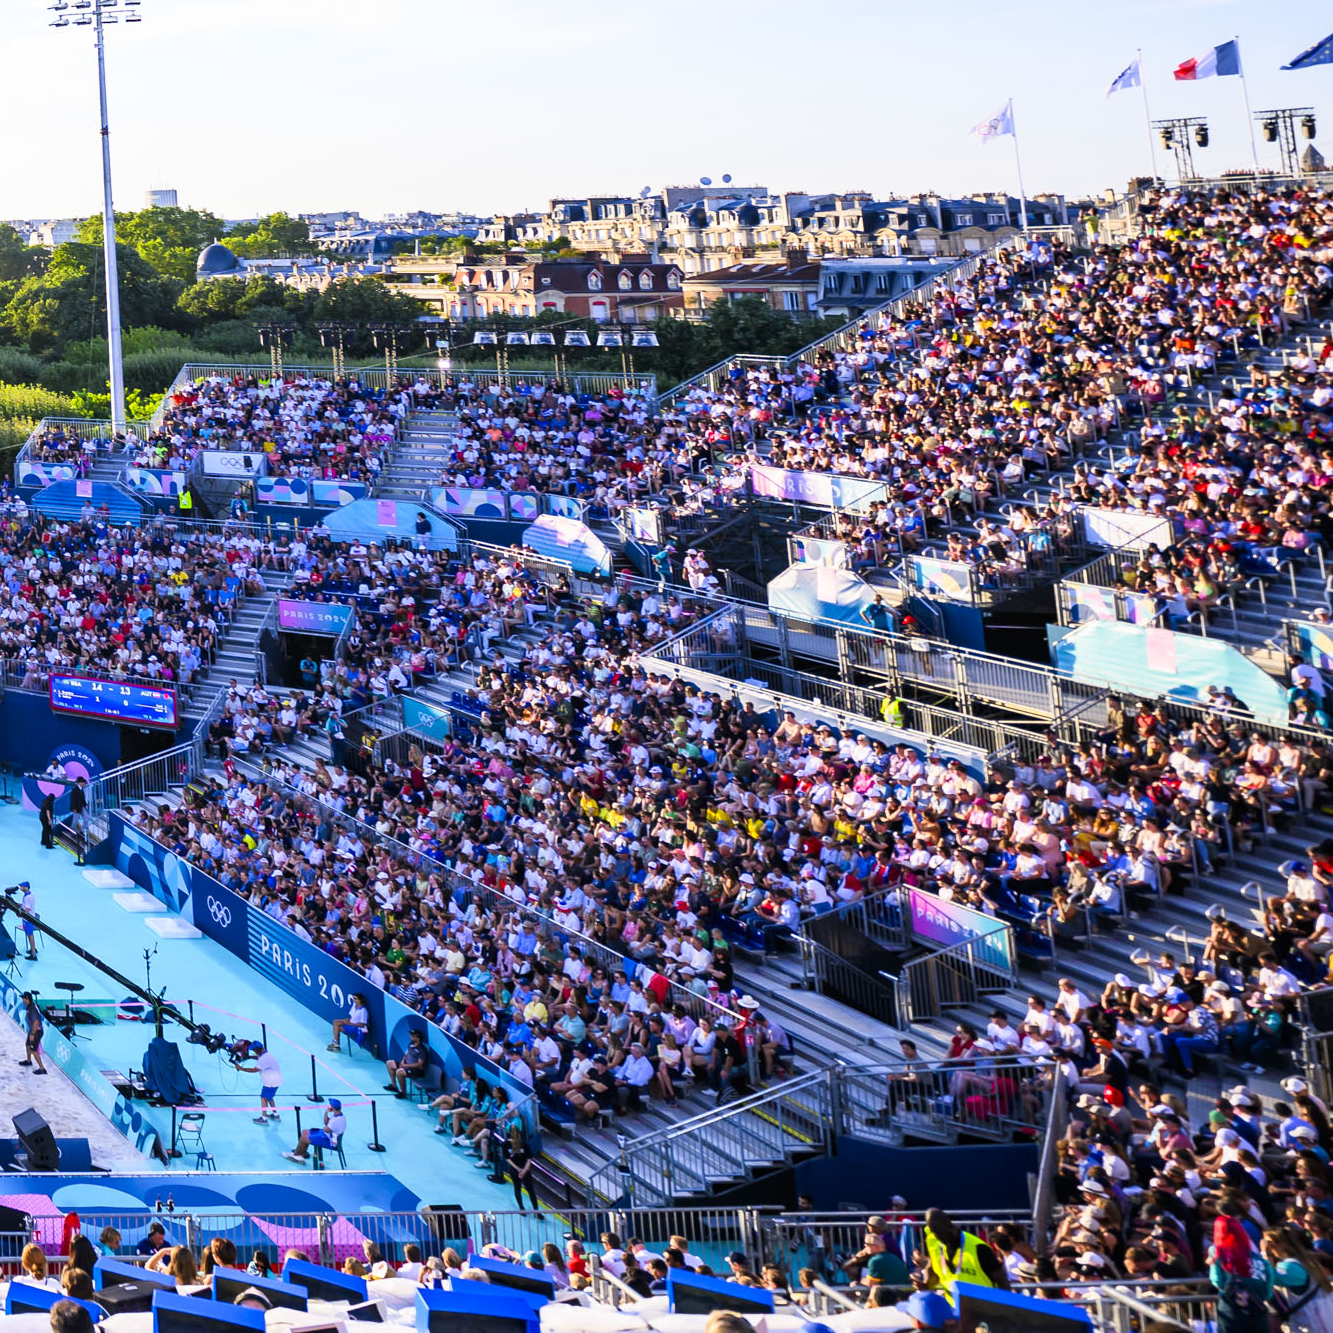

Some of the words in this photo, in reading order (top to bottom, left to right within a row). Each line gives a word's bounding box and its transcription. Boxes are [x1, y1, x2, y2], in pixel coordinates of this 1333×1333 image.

[92, 682, 103, 692] 14
[120, 687, 131, 696] 13
[261, 934, 312, 987] PARIS
